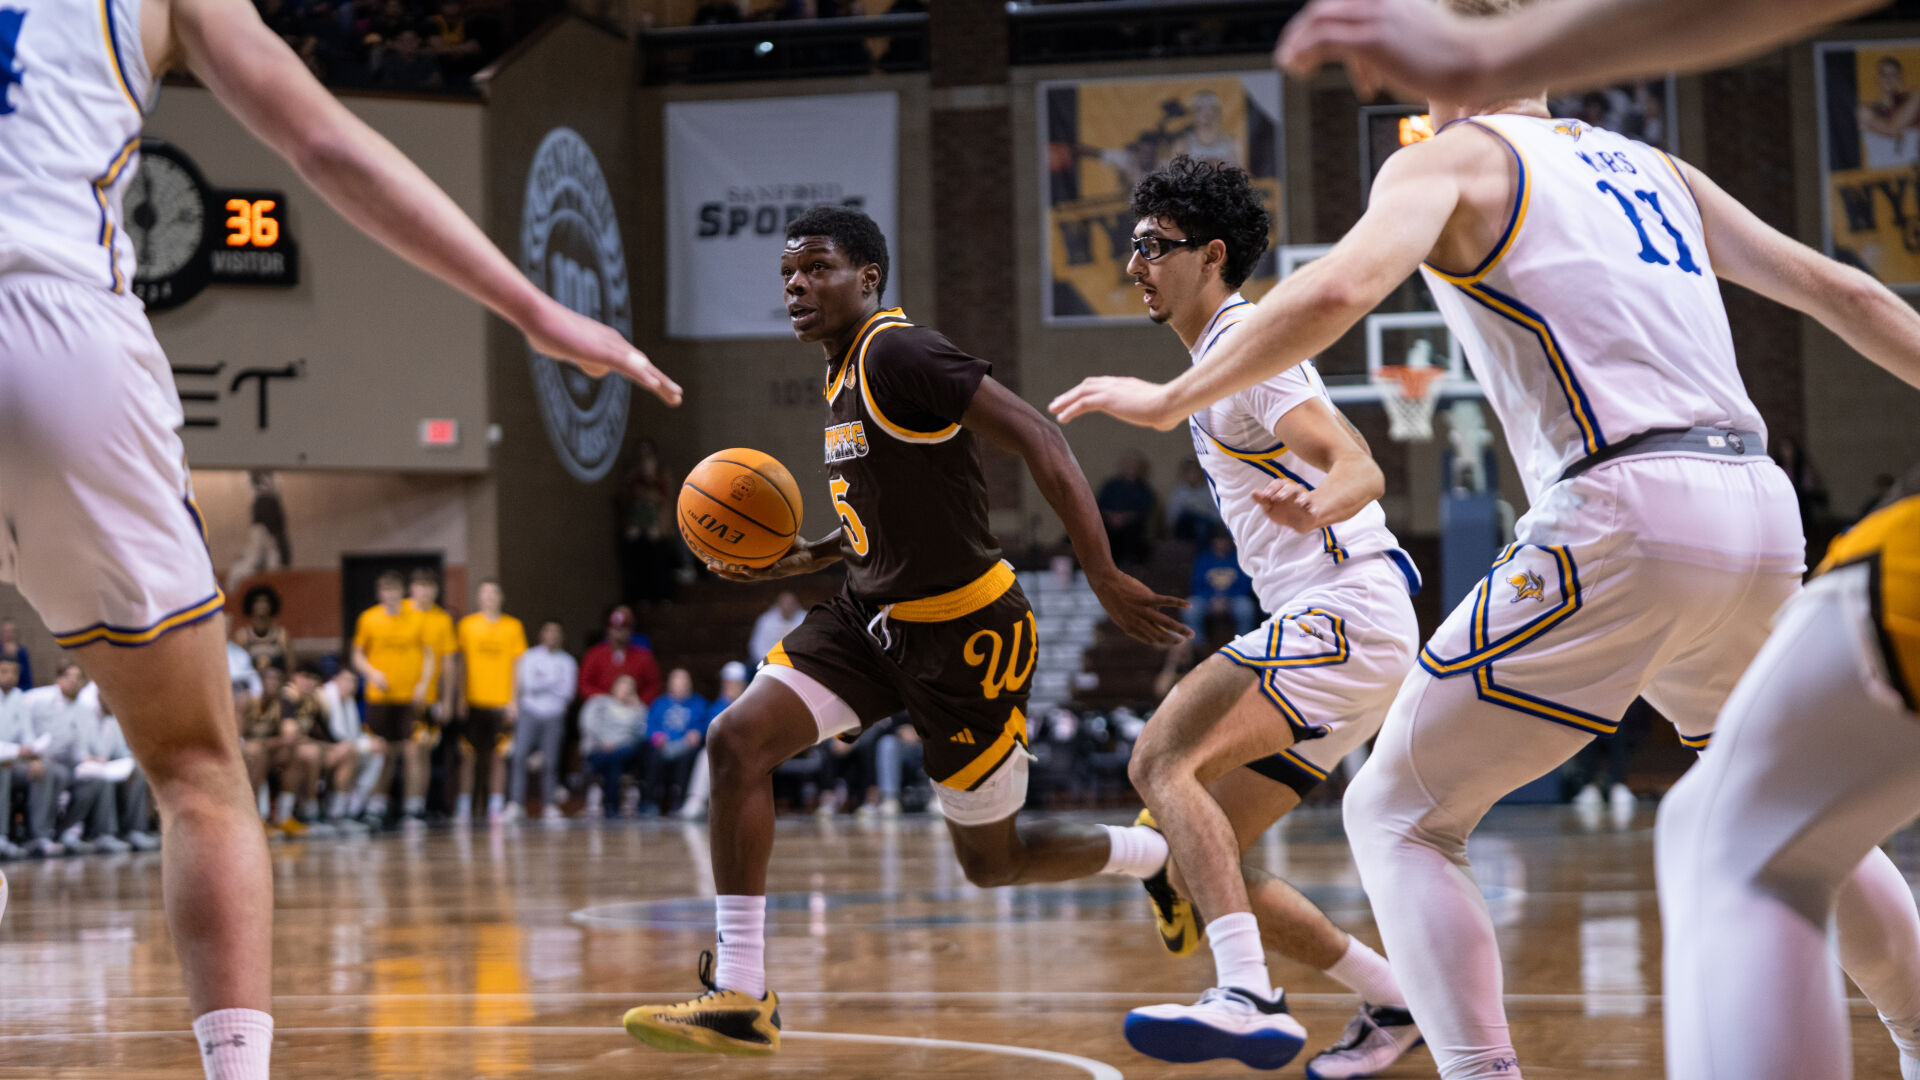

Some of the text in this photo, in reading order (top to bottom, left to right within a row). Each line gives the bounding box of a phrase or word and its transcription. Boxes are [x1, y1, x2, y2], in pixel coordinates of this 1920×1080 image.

[225, 198, 279, 247] 36
[1596, 180, 1702, 277] 11
[212, 252, 284, 273] VISITOR
[698, 513, 746, 544] EVO
[829, 474, 869, 556] 5
[963, 609, 1037, 699] W
